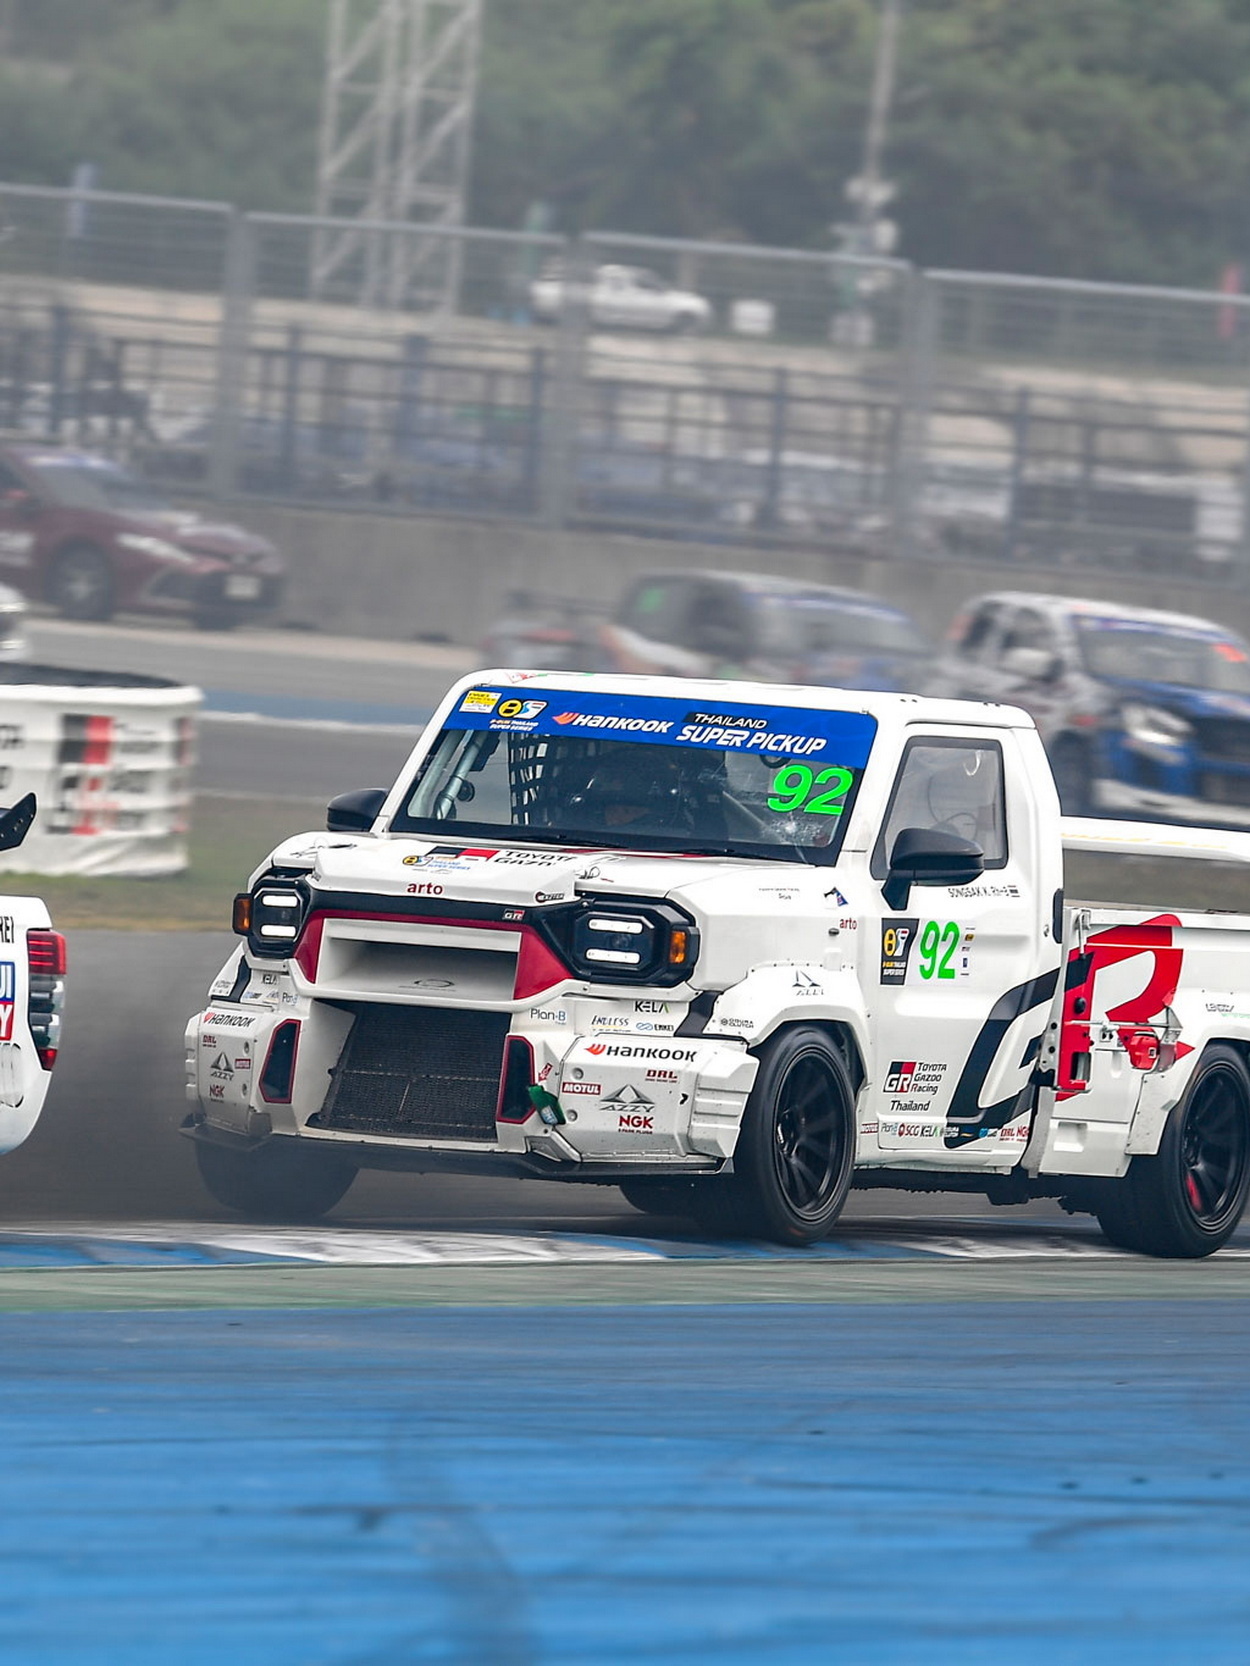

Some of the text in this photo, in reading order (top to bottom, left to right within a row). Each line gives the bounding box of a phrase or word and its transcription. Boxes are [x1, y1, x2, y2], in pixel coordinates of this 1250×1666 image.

[693, 713, 768, 730] THAILAND
[675, 724, 828, 756] SUPER PICKUP
[766, 763, 854, 816] 92
[407, 882, 443, 896] arto
[840, 917, 858, 930] arto
[919, 920, 960, 980] 92
[917, 1062, 948, 1072] TOYOTA
[884, 1073, 912, 1092] GR
[913, 1073, 942, 1082] GAZOO
[562, 1083, 600, 1095] MOTUL
[911, 1083, 939, 1096] Racing
[600, 1104, 656, 1113] AZZY
[890, 1100, 931, 1112] Thailand
[618, 1115, 654, 1130] NGK
